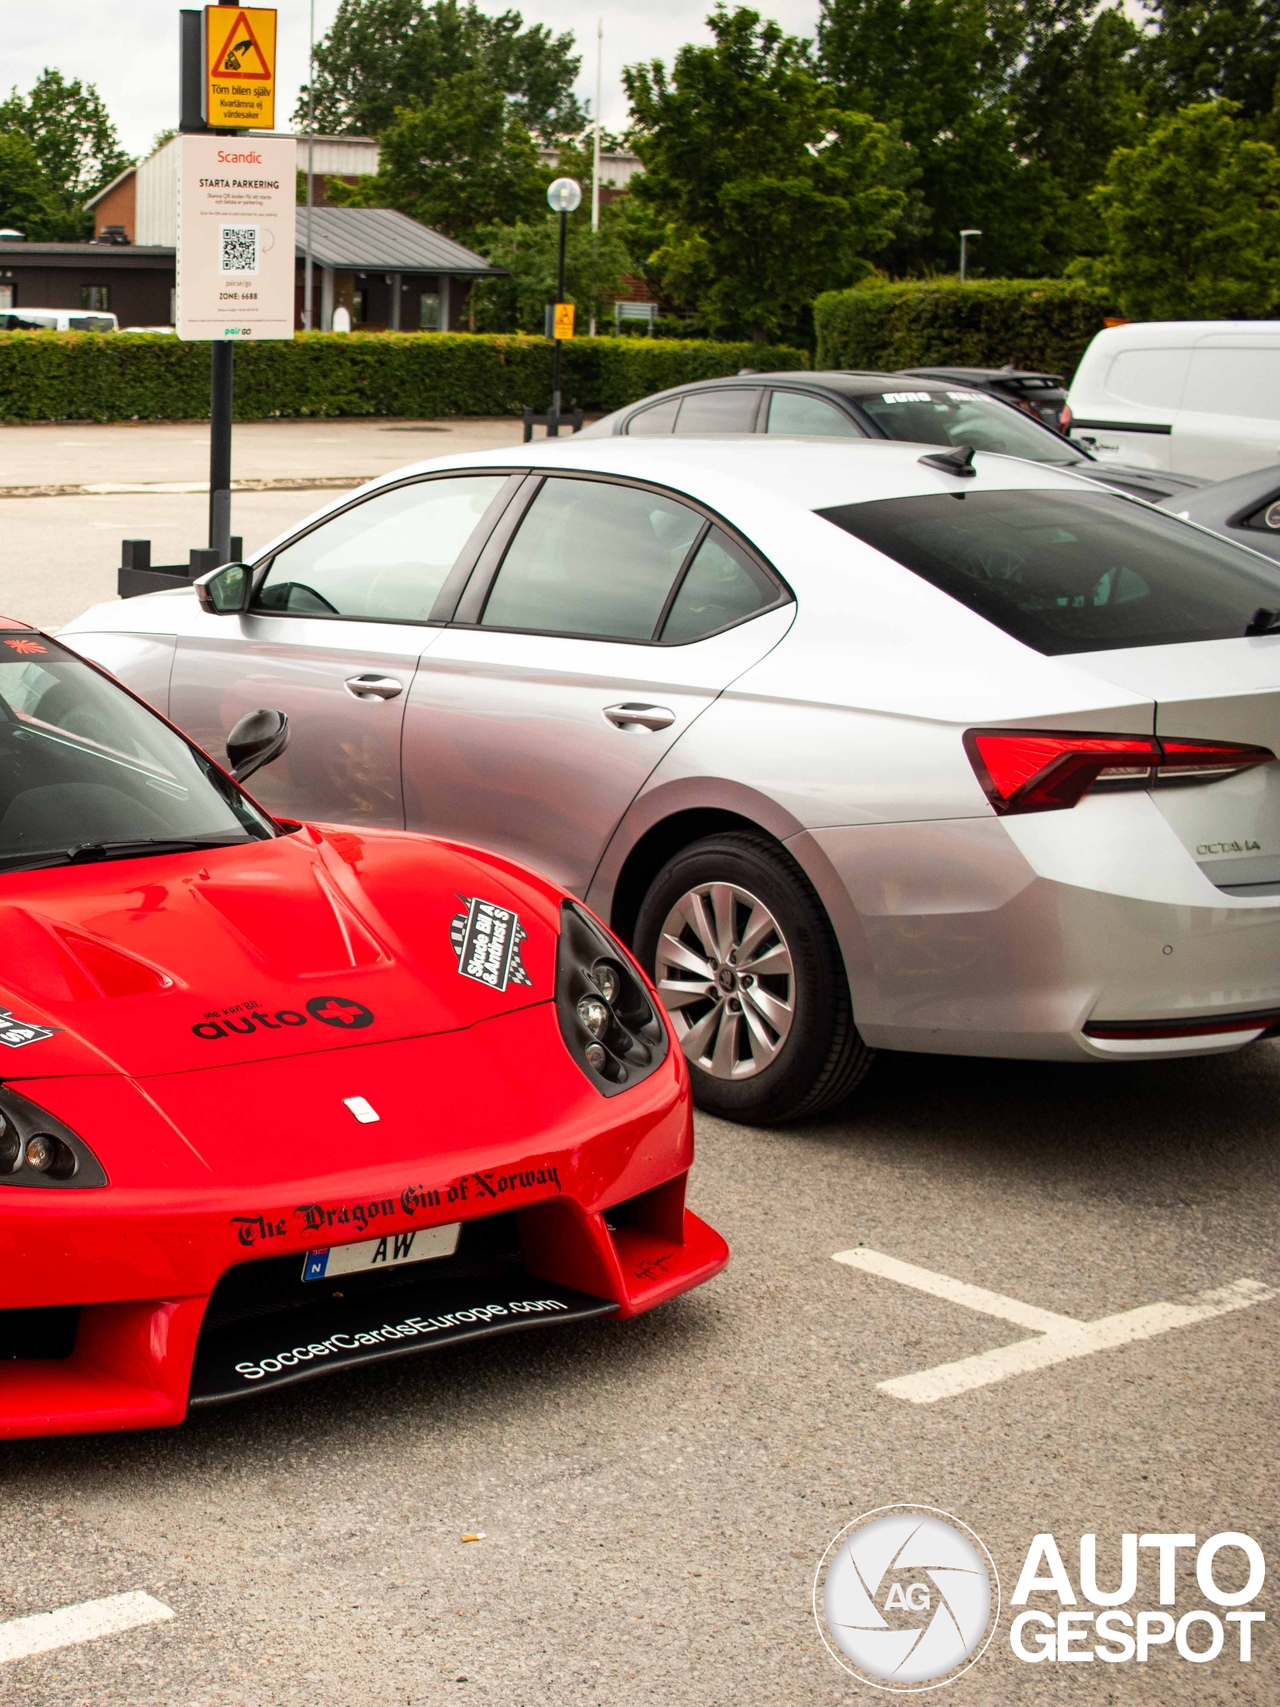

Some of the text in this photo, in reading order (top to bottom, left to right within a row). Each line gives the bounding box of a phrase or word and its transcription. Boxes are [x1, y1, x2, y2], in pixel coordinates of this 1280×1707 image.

[231, 85, 251, 96] bilen
[217, 150, 262, 164] Scandic
[199, 179, 279, 189] STARTA PARKERING
[224, 327, 241, 336] pair
[1196, 840, 1261, 855] OCTAVIA
[222, 1005, 243, 1016] kan
[229, 1166, 562, 1246] The Dragon Gin of Norway
[372, 1232, 417, 1265] AW
[235, 1298, 568, 1380] SoccerCardsEurope.com
